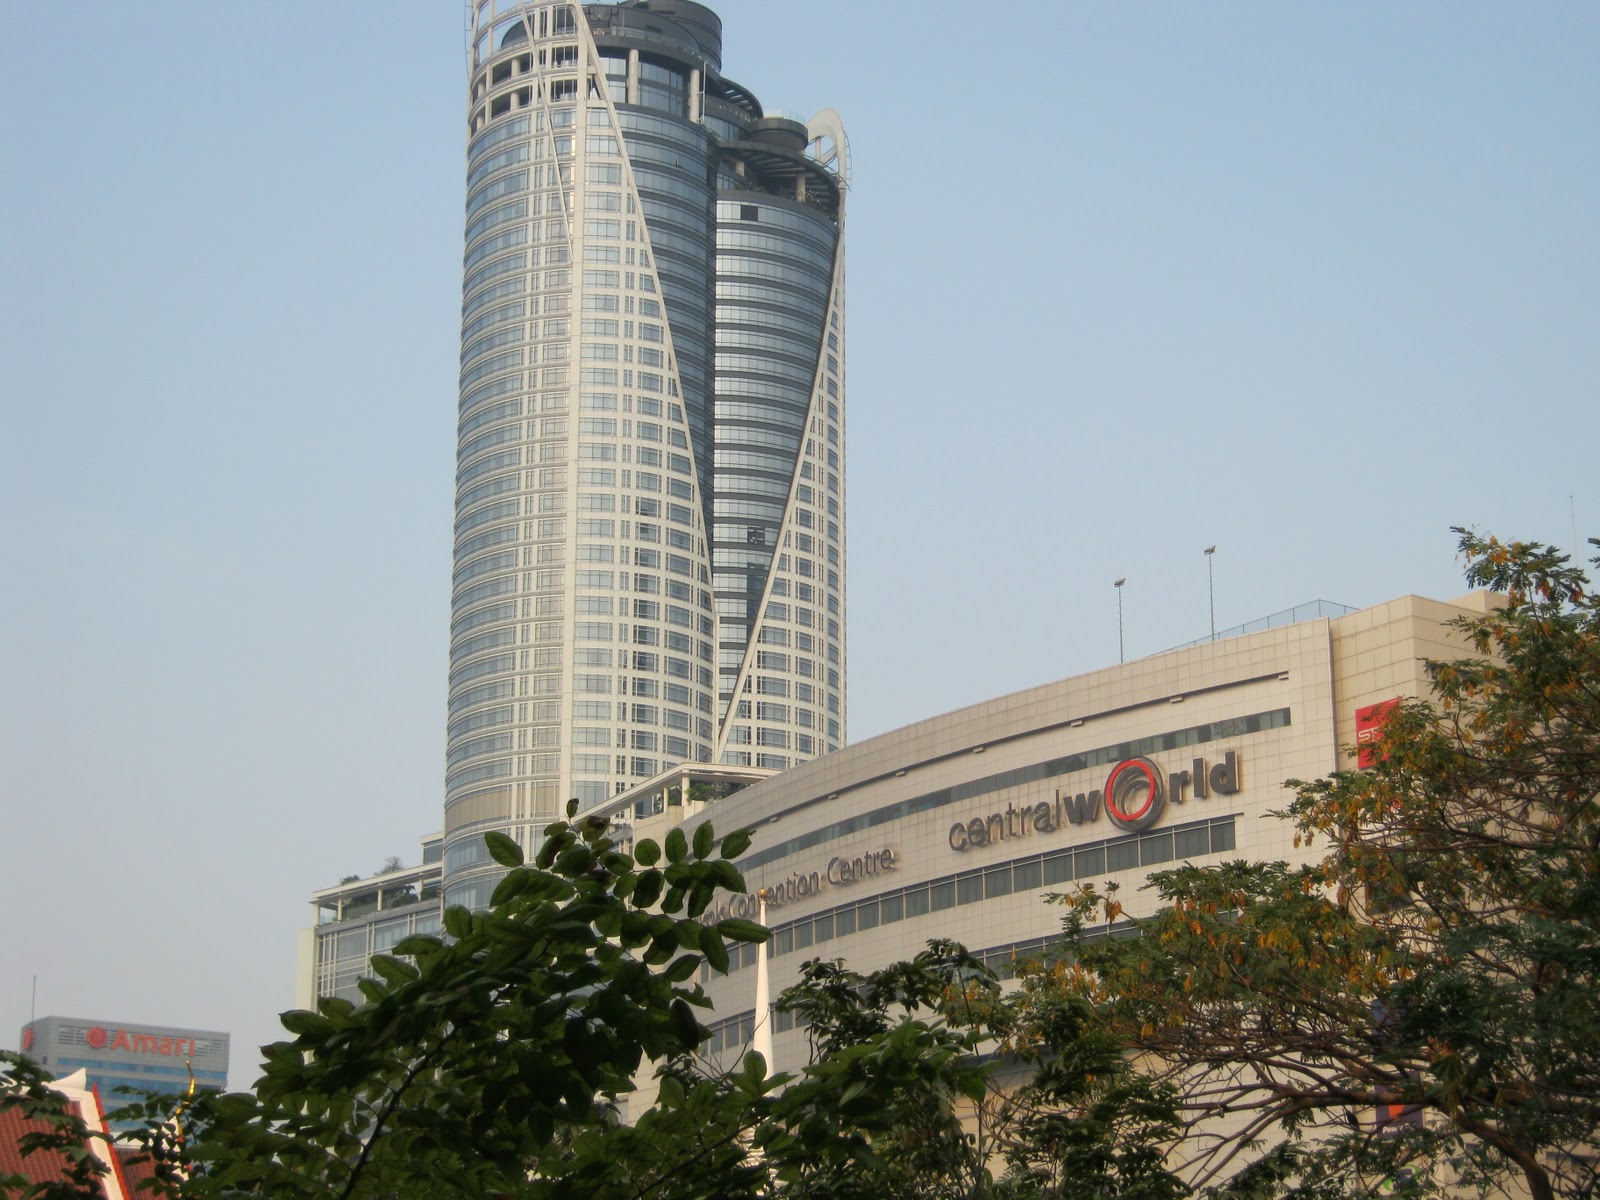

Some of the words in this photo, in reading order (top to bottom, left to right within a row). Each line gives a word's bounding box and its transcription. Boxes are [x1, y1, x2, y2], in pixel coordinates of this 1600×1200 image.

[728, 871, 820, 919] Conention
[827, 848, 895, 886] Centre
[110, 1028, 196, 1058] Amari
